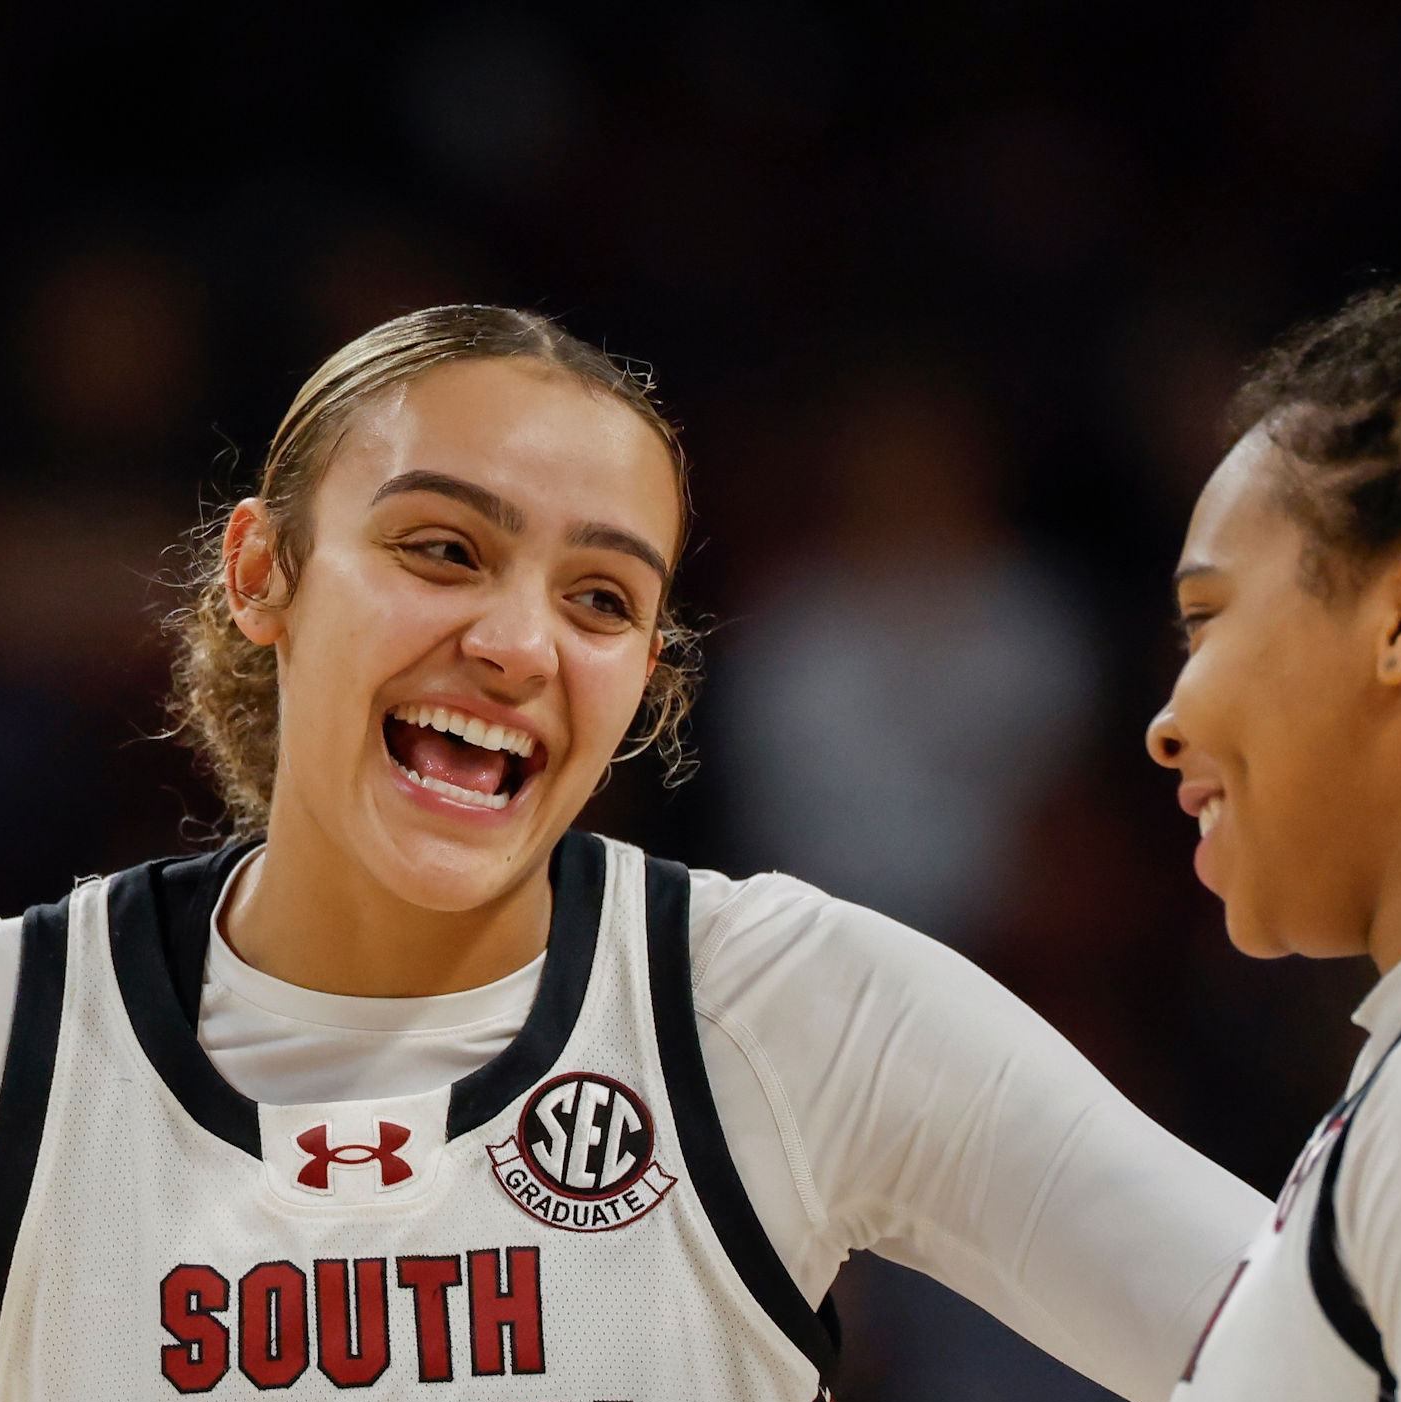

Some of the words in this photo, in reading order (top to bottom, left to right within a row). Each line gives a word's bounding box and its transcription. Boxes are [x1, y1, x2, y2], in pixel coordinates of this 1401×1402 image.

[531, 1080, 644, 1190] SEC
[504, 1168, 645, 1227] GRADUATE
[160, 1246, 546, 1394] SOUTH
